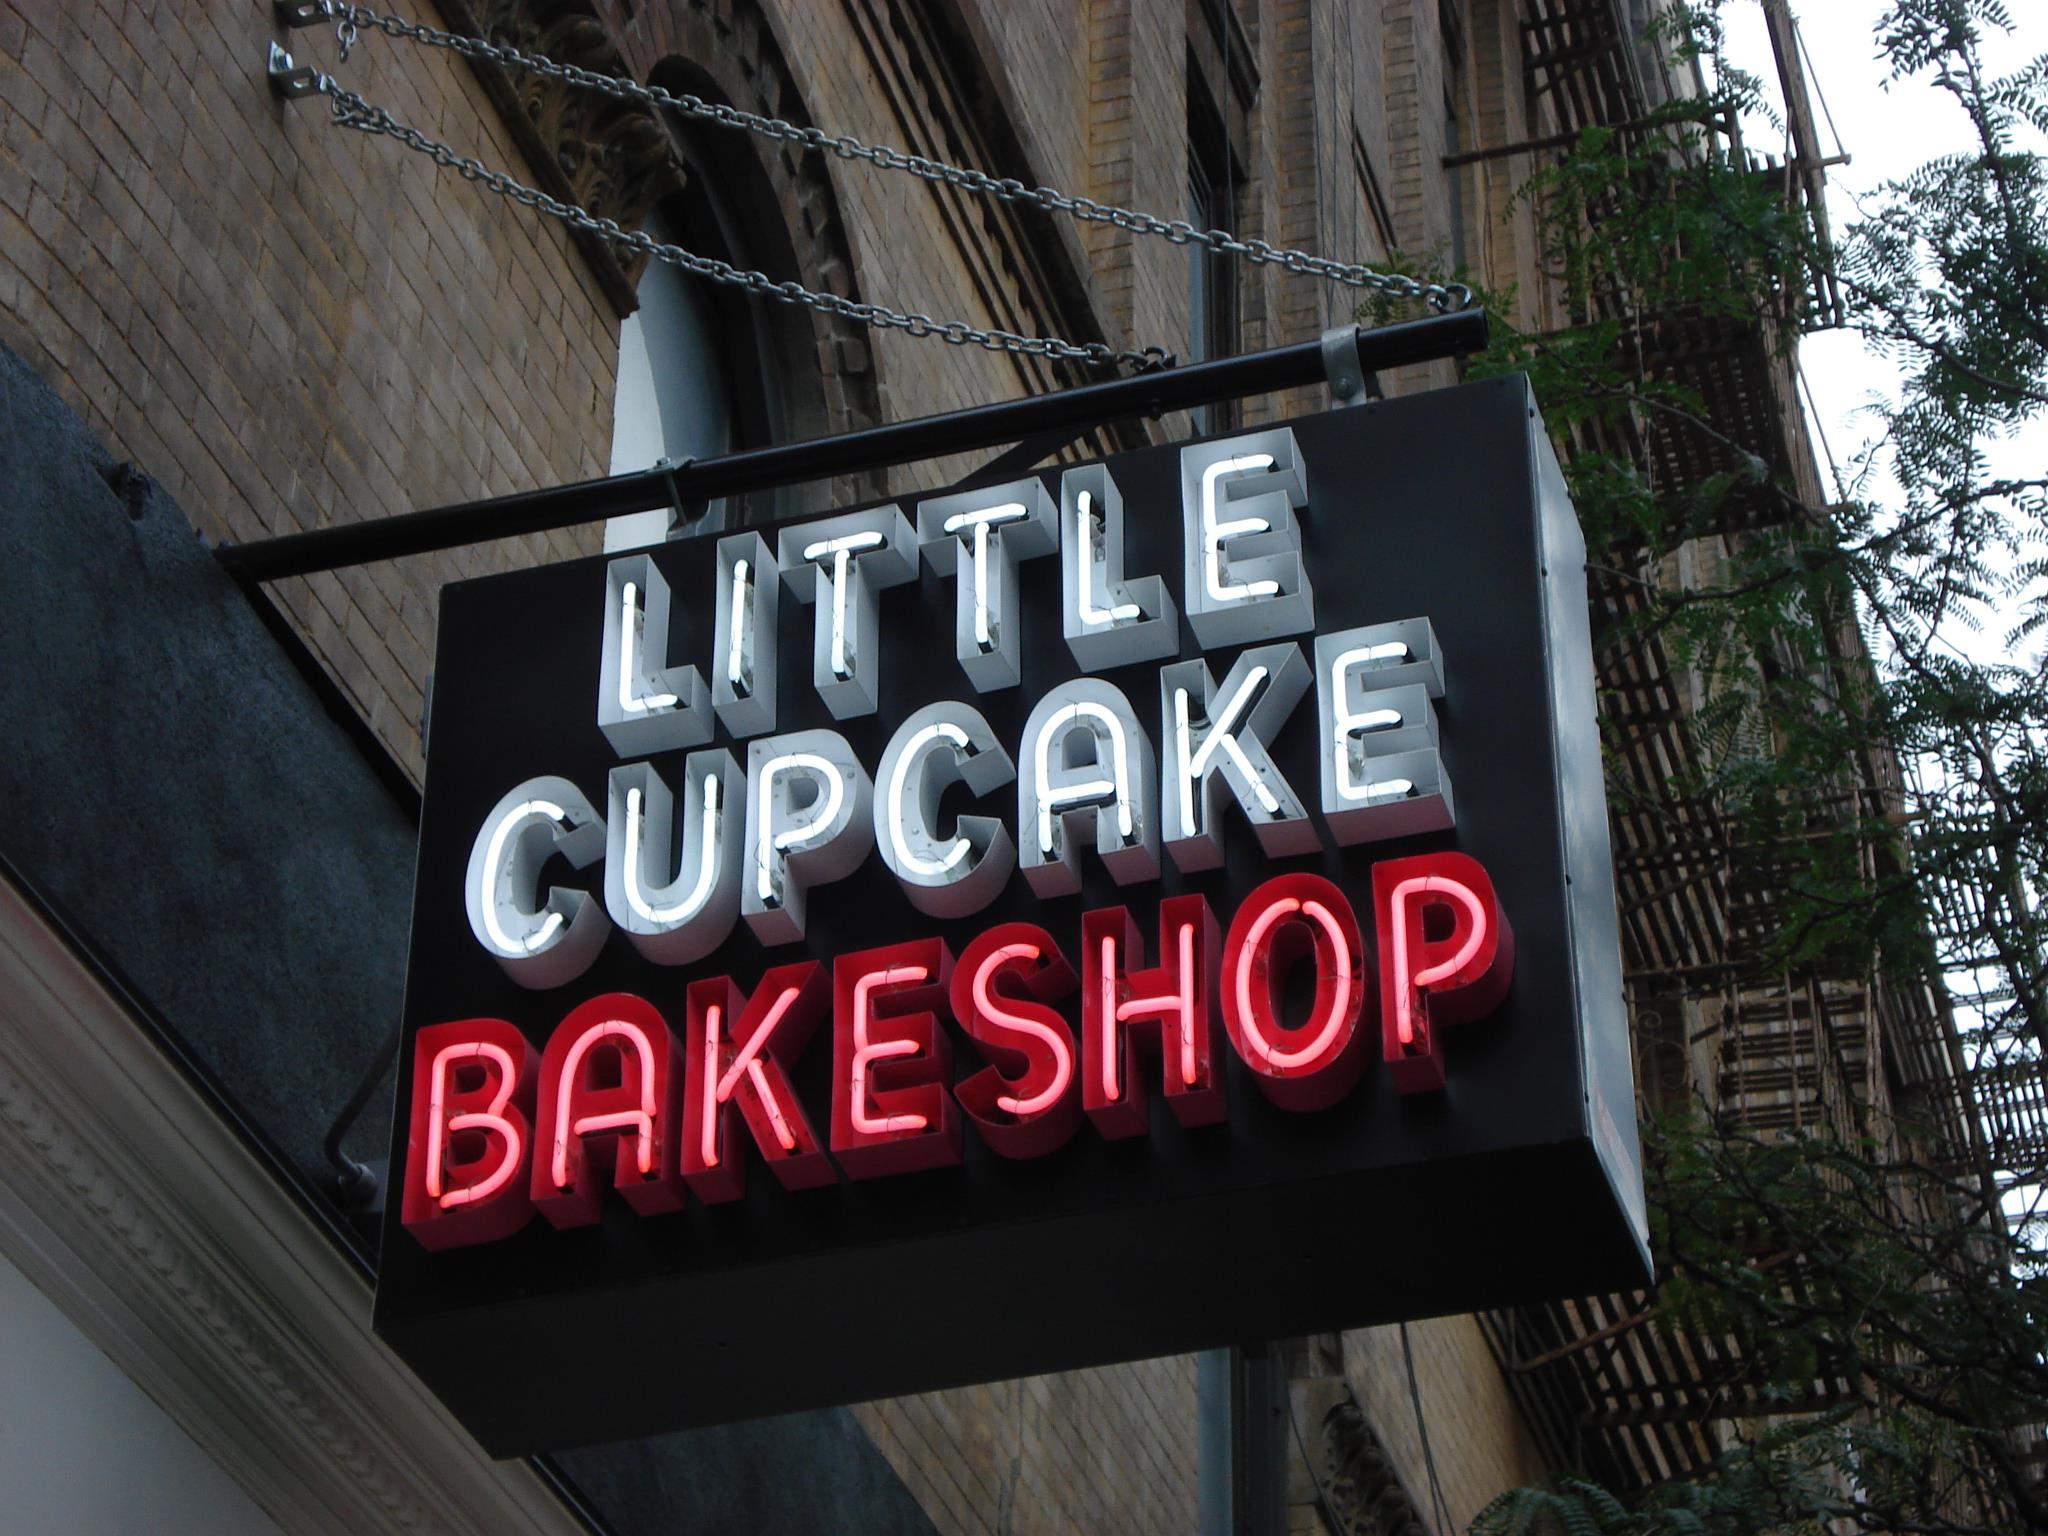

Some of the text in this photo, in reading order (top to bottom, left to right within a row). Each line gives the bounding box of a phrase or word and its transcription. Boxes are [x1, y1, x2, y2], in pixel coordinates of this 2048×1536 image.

[597, 427, 1315, 758] LITTLE
[465, 616, 1455, 988] CUPCAKE
[401, 851, 1514, 1250] BAKESHOP
